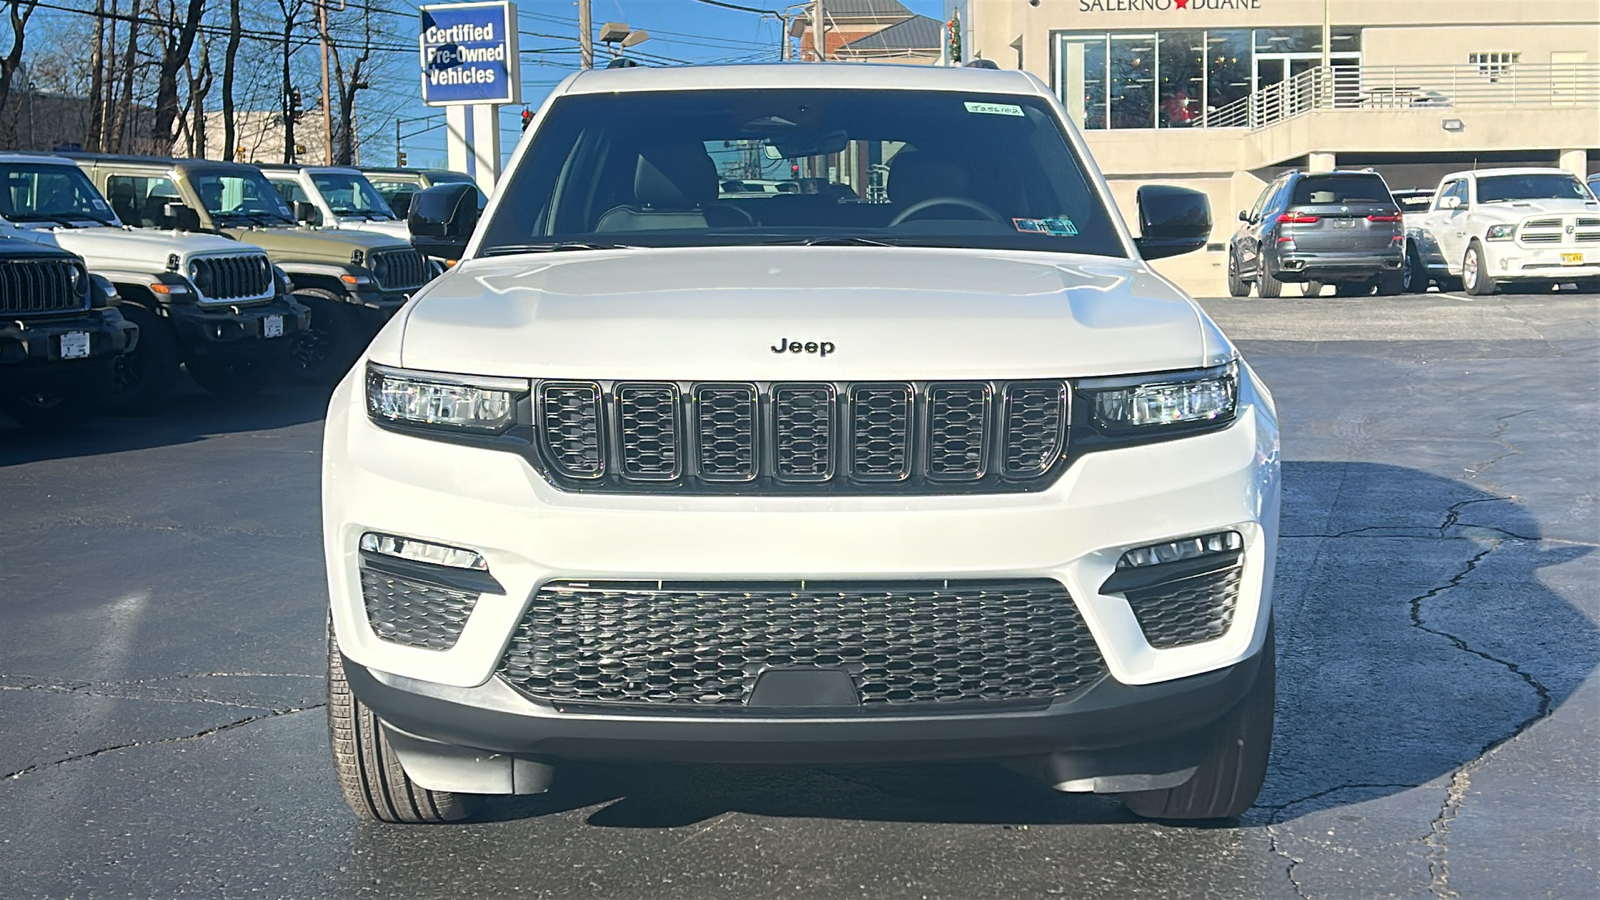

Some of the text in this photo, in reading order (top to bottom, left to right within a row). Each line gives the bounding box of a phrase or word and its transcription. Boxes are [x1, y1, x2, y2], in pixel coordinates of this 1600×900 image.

[1079, 0, 1262, 12] SALERNO DUANE
[426, 22, 494, 44] Certified
[427, 43, 504, 64] Pre-Owned
[429, 65, 495, 86] Vehicles
[770, 337, 836, 358] Jeep
